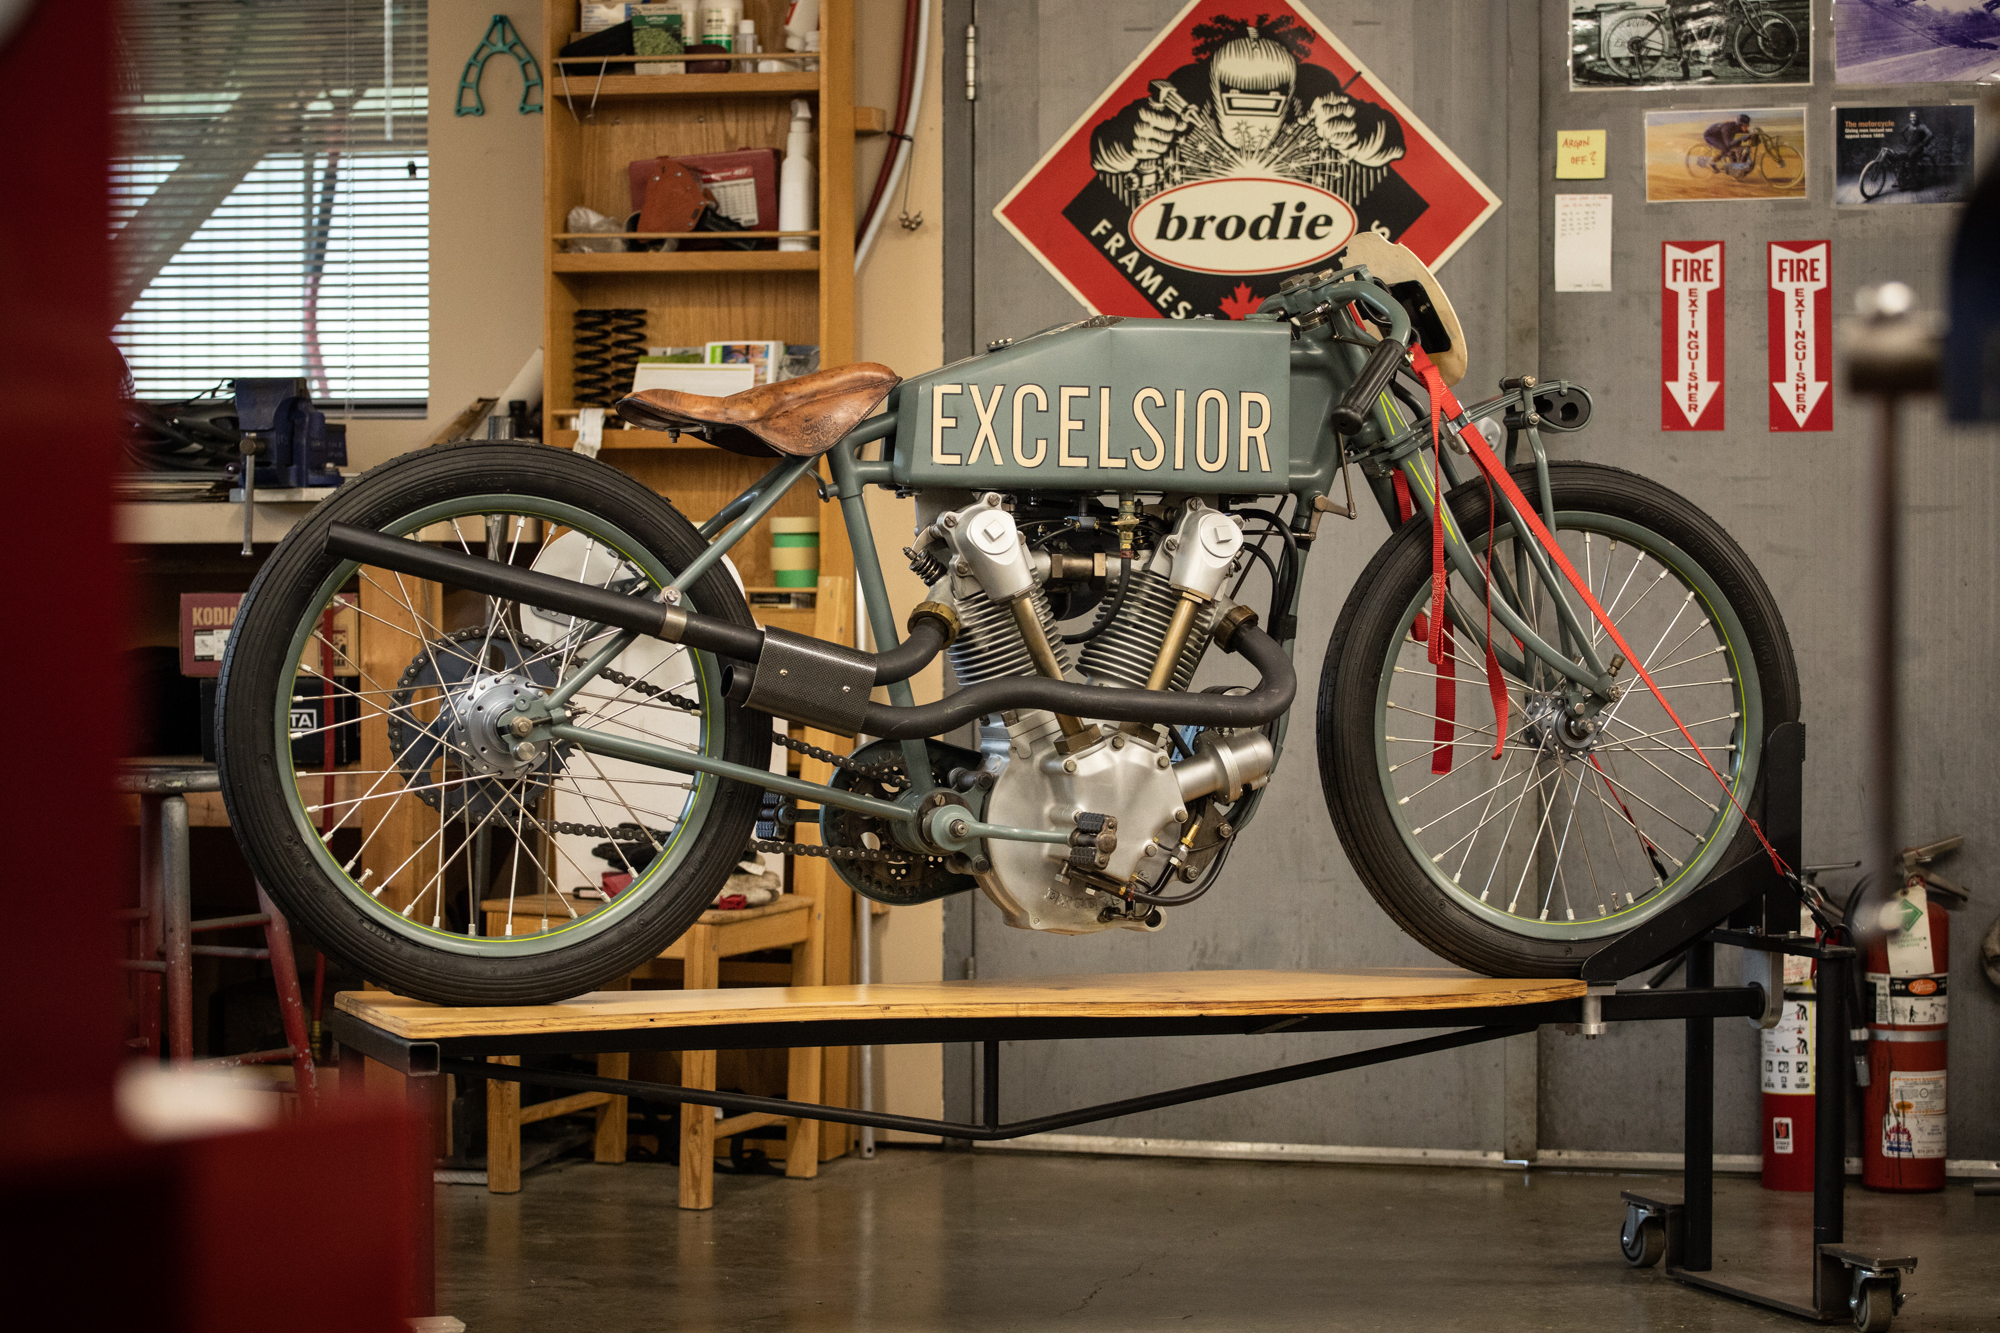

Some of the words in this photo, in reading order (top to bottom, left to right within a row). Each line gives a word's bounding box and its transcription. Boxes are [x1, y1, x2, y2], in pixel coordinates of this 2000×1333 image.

[1858, 120, 1895, 129] motorcycle
[1562, 136, 1591, 148] ARGON
[1155, 201, 1334, 242] brodie
[1090, 218, 1192, 320] FRAMES
[1672, 258, 1714, 283] FIRE
[1778, 258, 1820, 283] FIRE
[1687, 287, 1700, 413] EXTINGUISHER
[1794, 287, 1807, 413] EXTINGUISHER
[931, 383, 1272, 473] EXCELSIOR
[192, 606, 239, 626] KODIA
